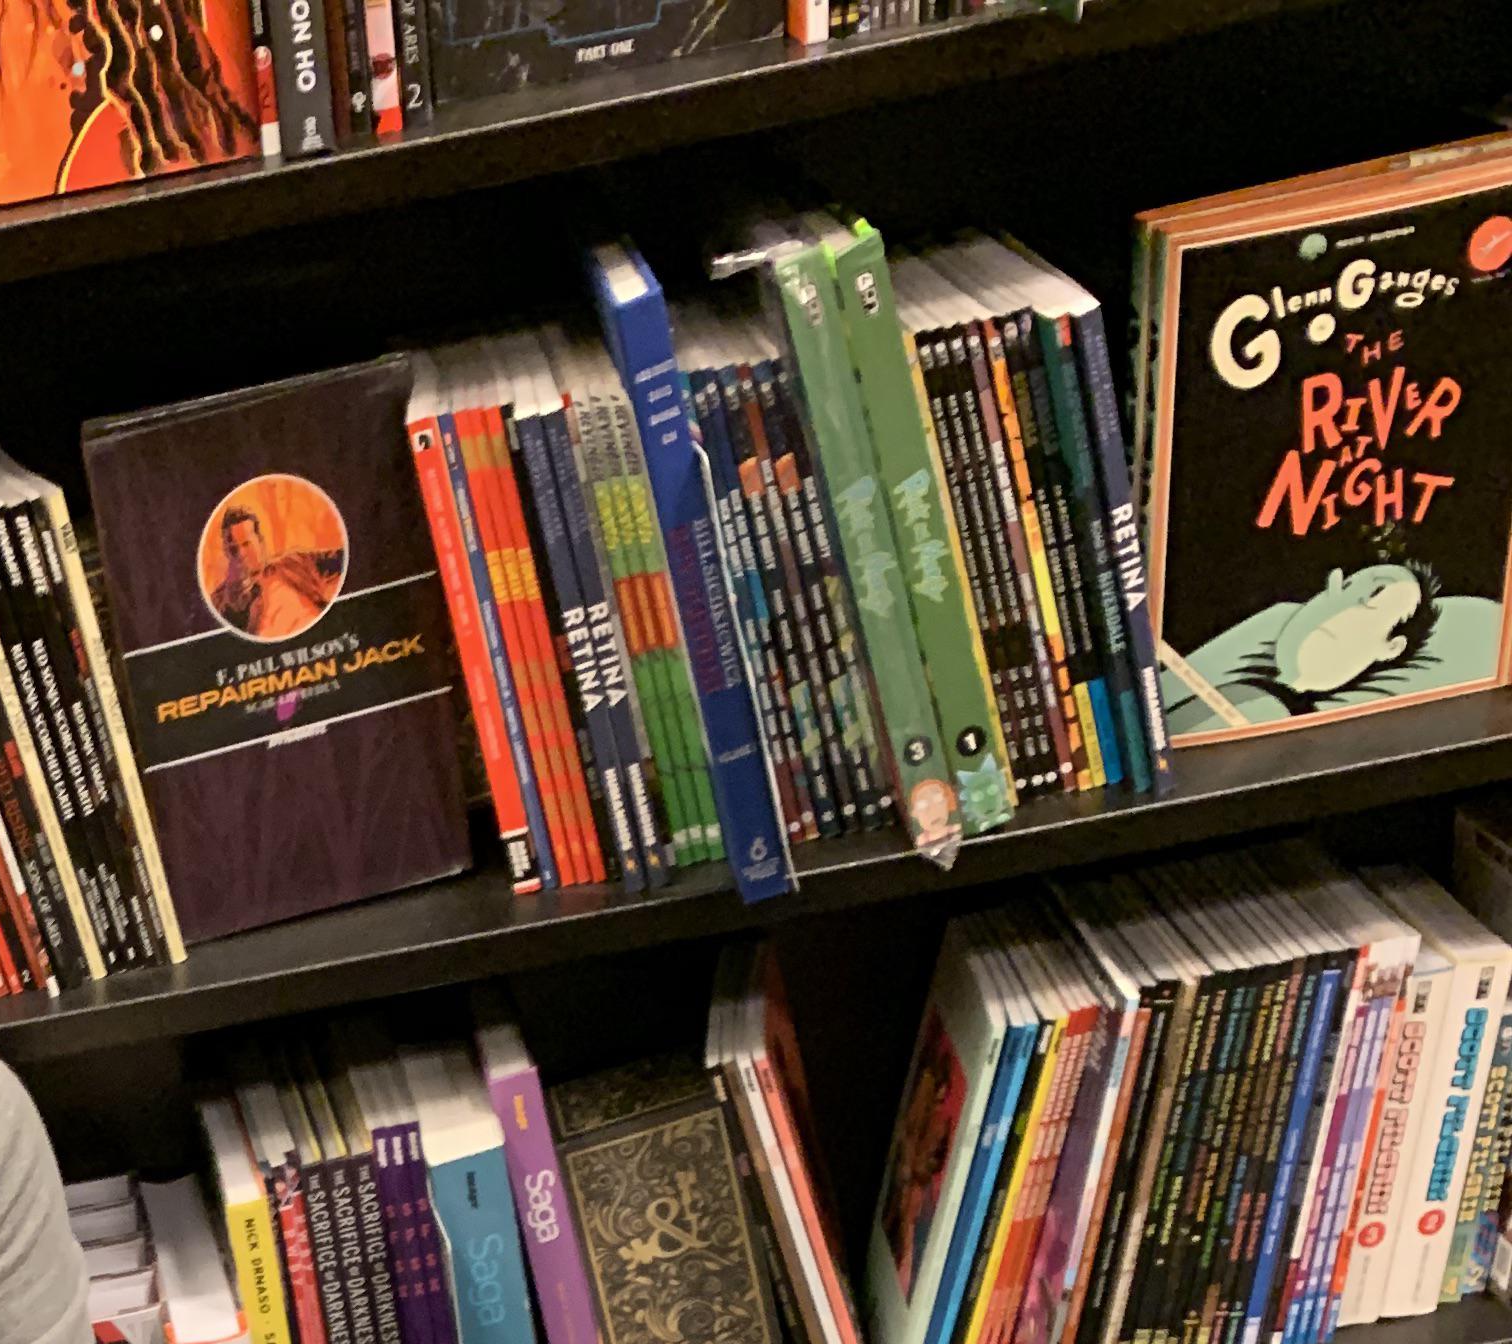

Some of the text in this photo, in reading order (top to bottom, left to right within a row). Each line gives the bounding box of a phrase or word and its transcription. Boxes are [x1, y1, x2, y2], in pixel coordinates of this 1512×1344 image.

[407, 84, 424, 110] 2
[1210, 257, 1460, 390] Glenn Ganges
[1344, 328, 1405, 366] THE
[1301, 365, 1462, 455] RIVER
[1335, 434, 1372, 467] AT
[1254, 449, 1455, 538] NIGHT
[1109, 500, 1150, 612] RETINA
[1097, 569, 1124, 654] RIVERDALE
[157, 632, 426, 724] REPAIRMAN JACK
[238, 633, 360, 680] PAUL WILSON'S
[563, 605, 605, 713] RETINA
[587, 600, 628, 708] RETINA
[9, 642, 75, 822] RED SCORCHED EARTH
[30, 637, 95, 817] RED SCORCHED EARTH
[69, 700, 87, 726] RED
[910, 740, 927, 761] 3
[964, 732, 978, 751] 1
[750, 836, 768, 862] 6
[24, 856, 64, 949] SONS OF ARES
[1388, 1017, 1428, 1106] SCOTT
[1425, 1003, 1490, 1206] SCOTT PILGRIM
[1458, 1062, 1508, 1225] SCOTT PILGRIM
[307, 1174, 321, 1191] THE
[332, 1169, 346, 1186] THE
[356, 1164, 371, 1182] THE
[520, 1167, 565, 1245] Saga
[243, 1217, 259, 1252] NICK
[306, 1191, 336, 1272] SACRIFICE
[331, 1186, 362, 1267] SACRIFICE
[356, 1181, 387, 1263] SACRIFICE
[250, 1257, 270, 1315] DRNASO
[458, 1231, 516, 1328] Saga
